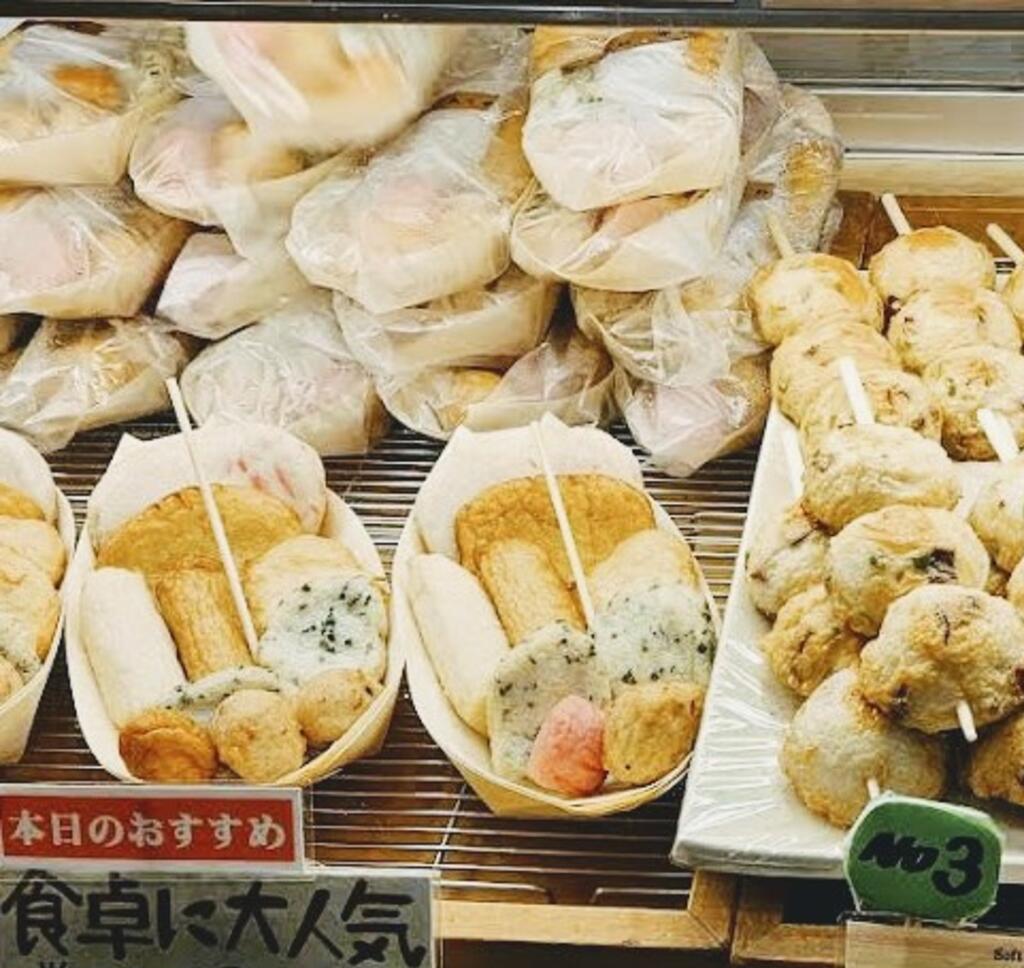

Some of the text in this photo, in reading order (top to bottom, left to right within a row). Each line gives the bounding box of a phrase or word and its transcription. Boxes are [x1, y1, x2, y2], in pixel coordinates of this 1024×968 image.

[9, 808, 287, 850] 本日のおすすめ
[0, 868, 427, 968] 食卓に大人気
[993, 947, 1023, 962] Soft
